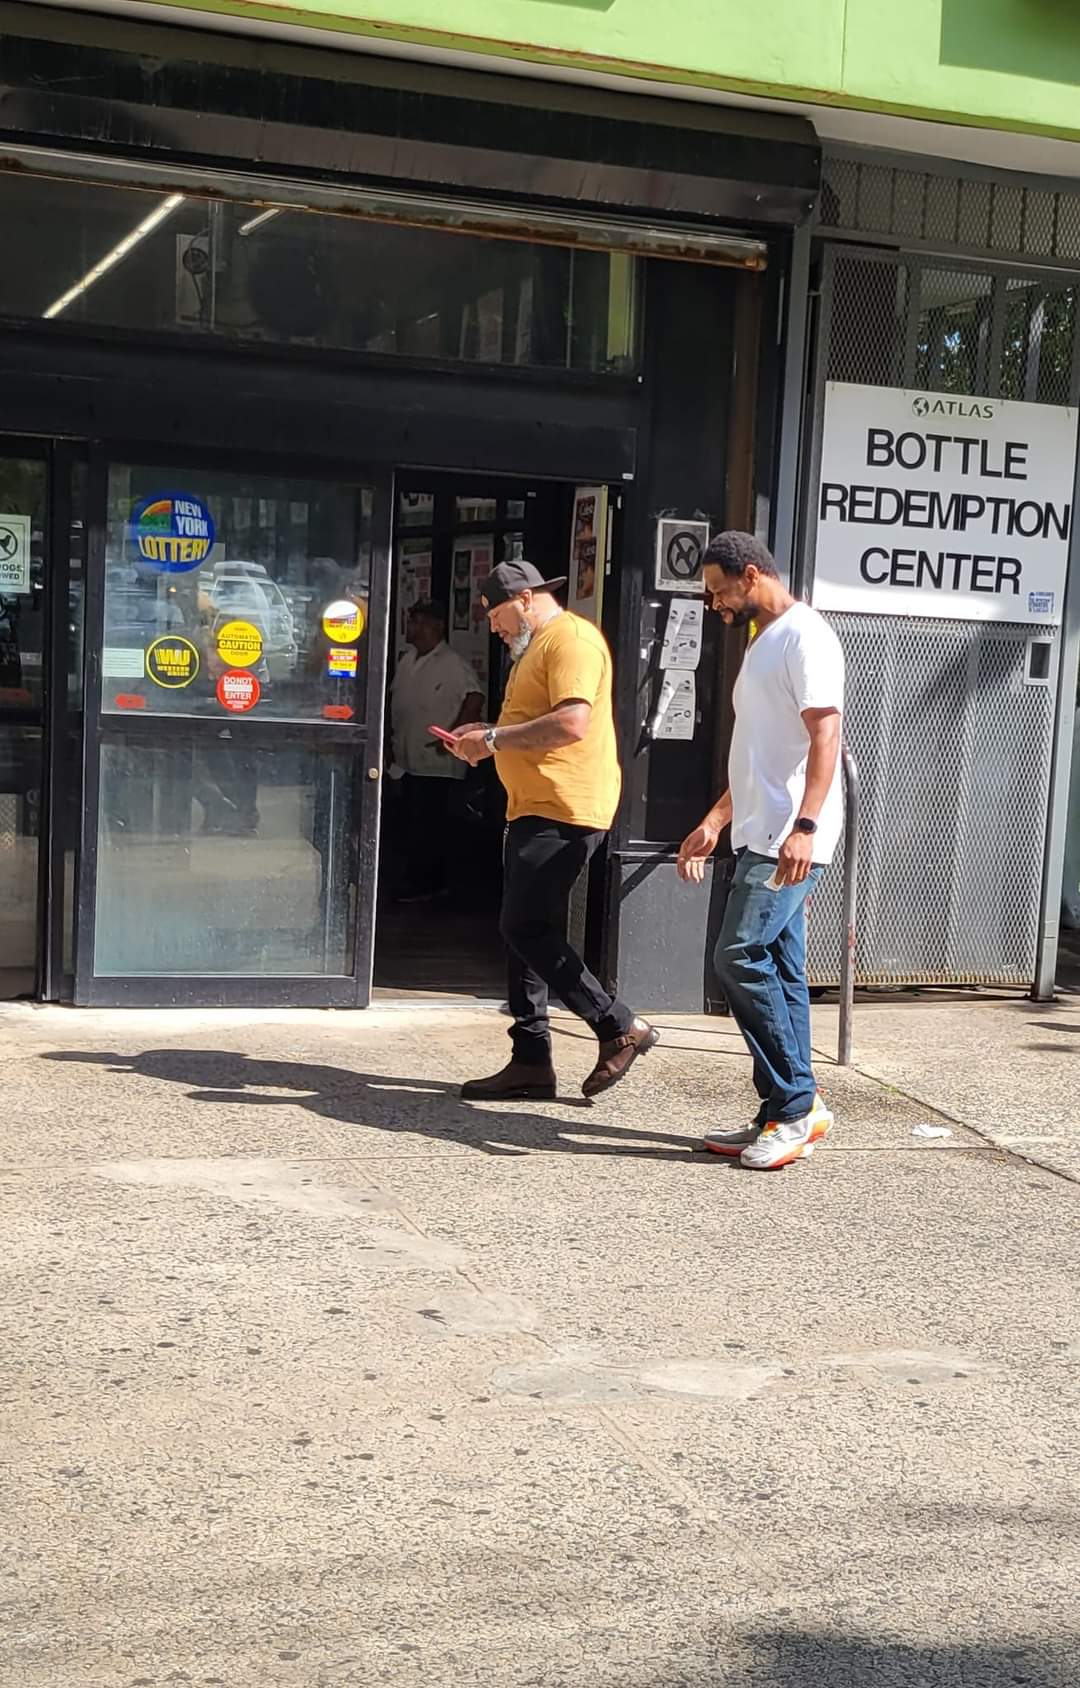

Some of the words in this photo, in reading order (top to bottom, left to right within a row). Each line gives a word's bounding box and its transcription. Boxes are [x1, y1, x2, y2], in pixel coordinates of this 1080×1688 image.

[932, 399, 993, 419] ATLAS
[866, 428, 1029, 480] BOTTLE
[174, 500, 202, 518] NEW
[820, 482, 1070, 541] REDEMPTION
[176, 515, 208, 537] YORK
[138, 536, 210, 563] LOTTERY
[859, 547, 1022, 595] CENTER
[219, 640, 261, 651] CAUTION
[225, 691, 251, 699] ENTER
